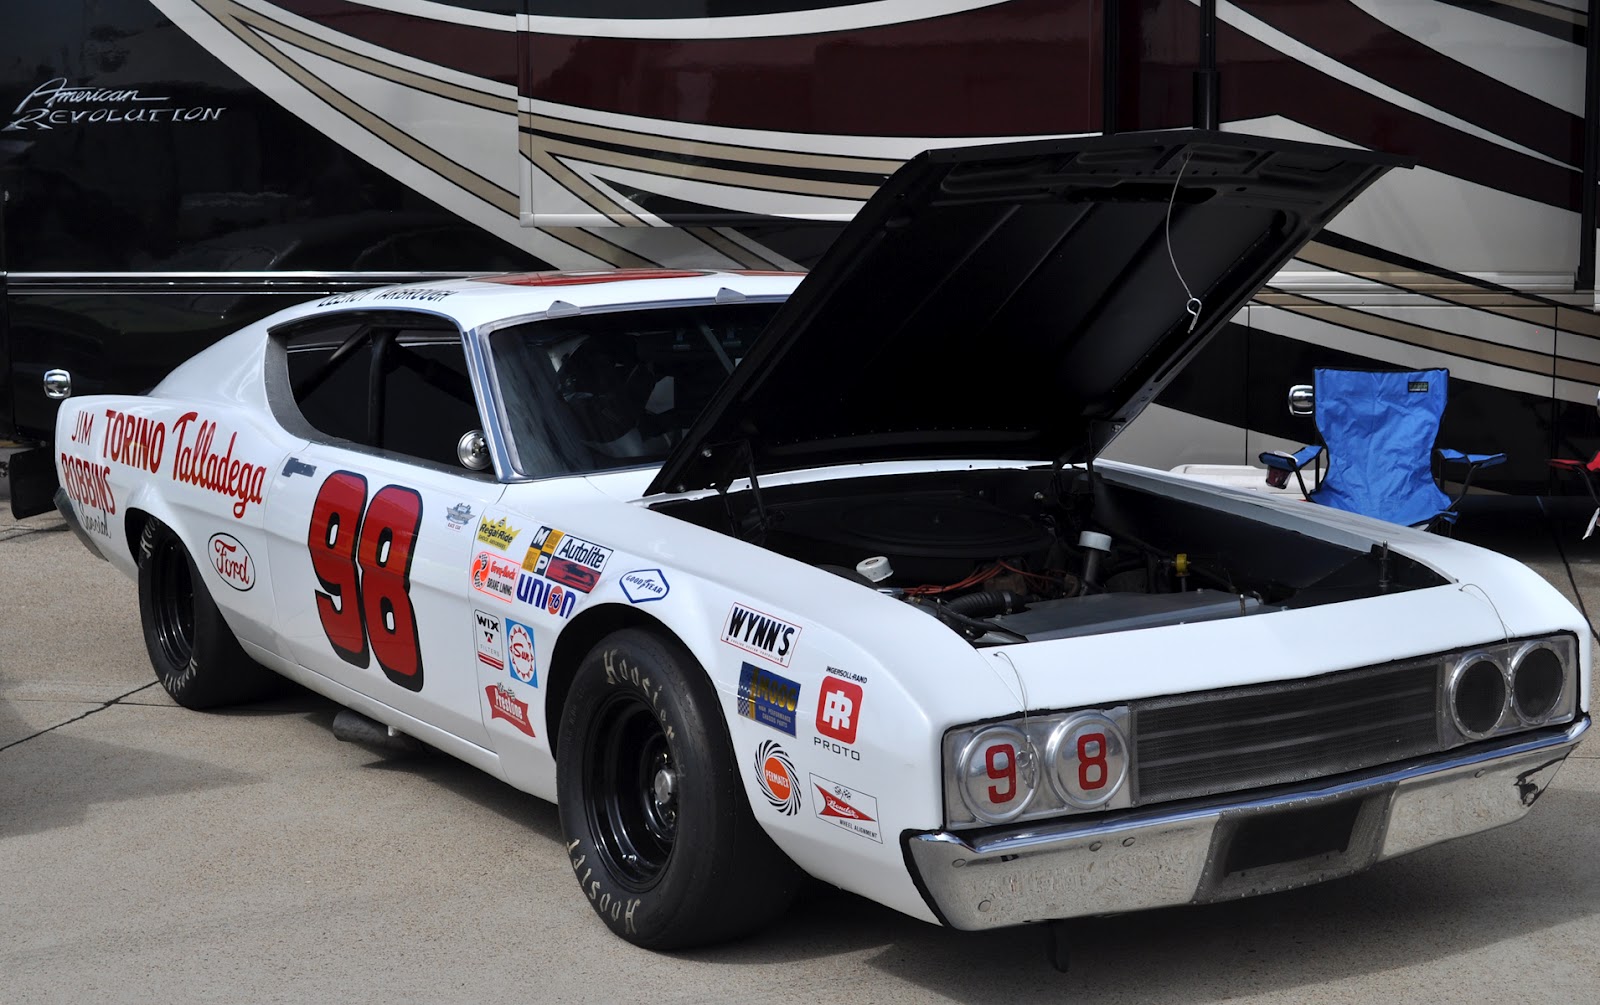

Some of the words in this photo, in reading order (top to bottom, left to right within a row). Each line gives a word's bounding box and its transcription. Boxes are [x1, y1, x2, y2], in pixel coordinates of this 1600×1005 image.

[13, 77, 170, 114] American
[1, 106, 227, 131] REVOLUTION
[72, 410, 94, 446] JIM
[103, 409, 166, 474] TORINO
[172, 411, 267, 519] Talladega
[61, 452, 116, 515] ROBBINS
[214, 539, 250, 585] Ford
[558, 538, 605, 569] Autolite
[307, 469, 424, 693] 98
[476, 614, 500, 632] WIX
[728, 606, 796, 656] WYNN'S
[826, 666, 868, 684] INGERSOLL-RAND
[814, 736, 860, 761] PROTO
[985, 744, 1017, 804] 9
[1077, 732, 1109, 790] 8
[839, 819, 854, 831] WHEEL
[854, 825, 878, 839] ALIGNMENT
